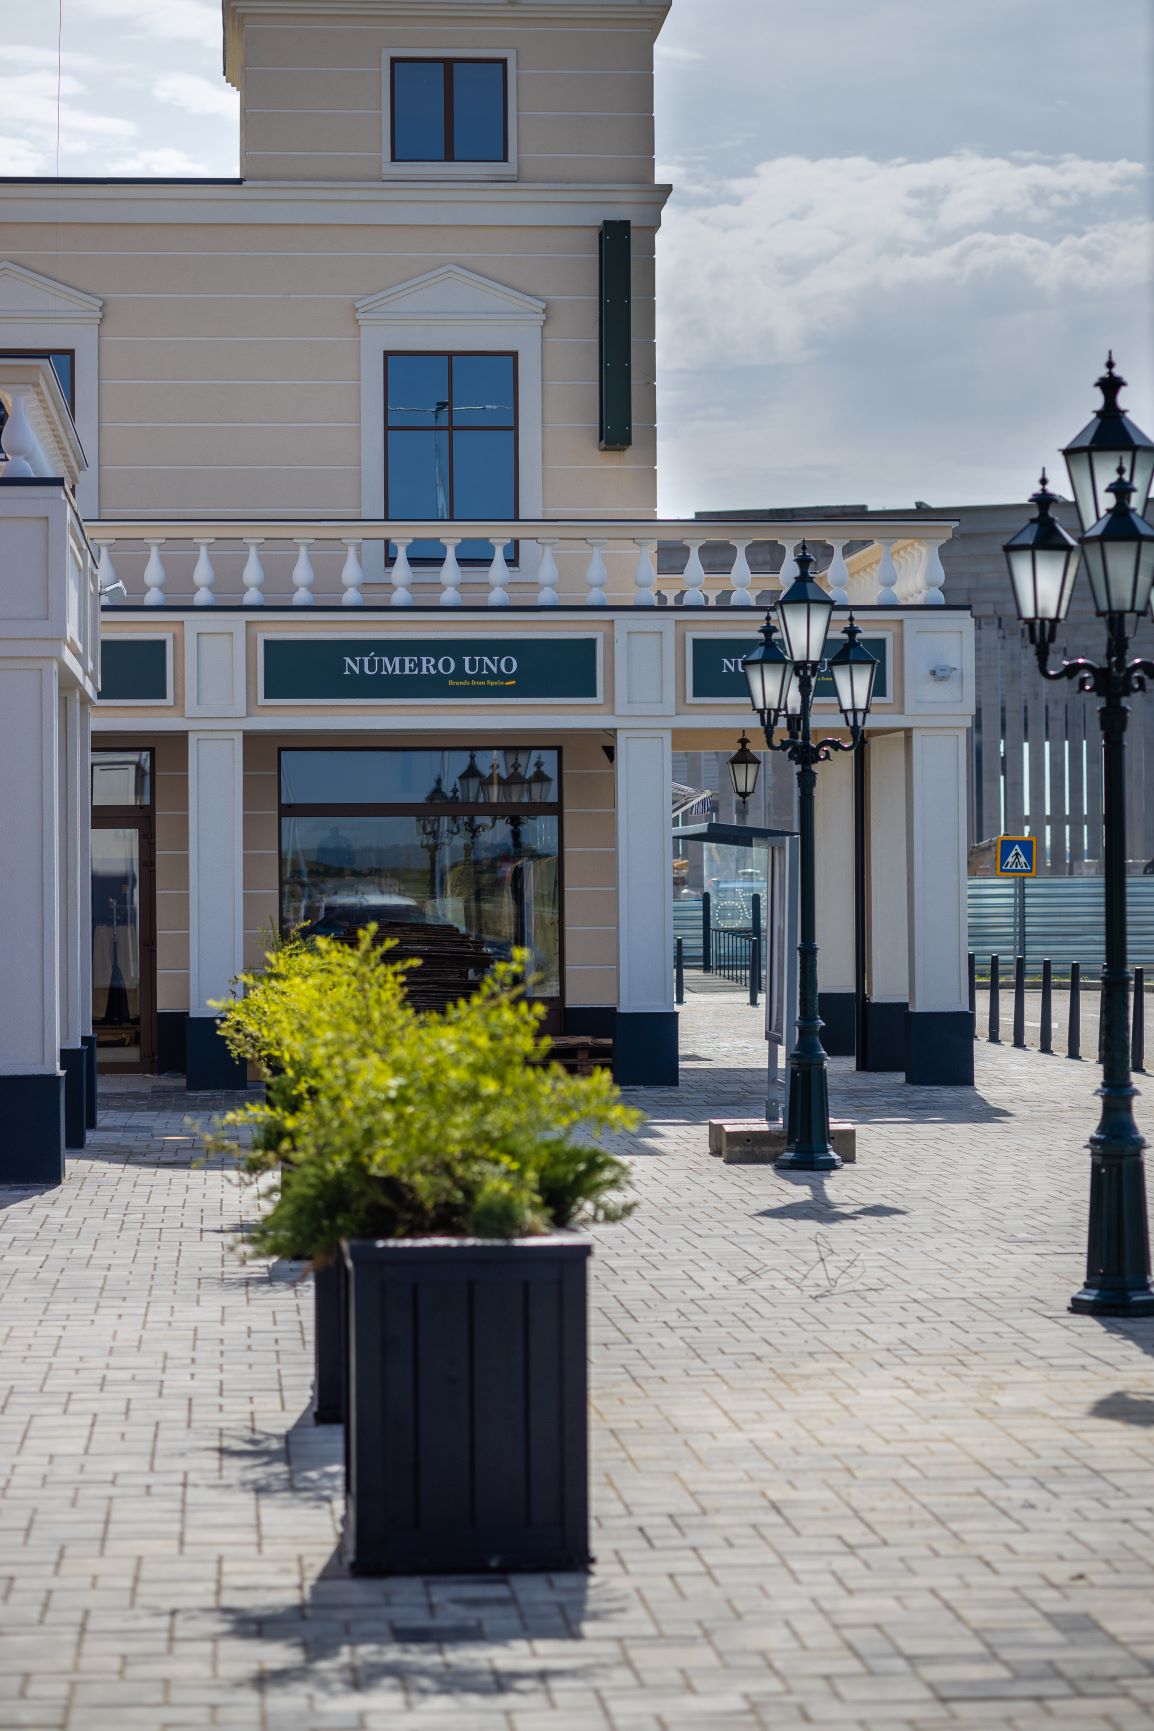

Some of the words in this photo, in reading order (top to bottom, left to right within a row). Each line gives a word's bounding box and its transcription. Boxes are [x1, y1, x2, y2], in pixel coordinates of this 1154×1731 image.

[343, 652, 455, 674] NÚMERO
[463, 656, 517, 674] UNO
[486, 679, 504, 687] Spain
